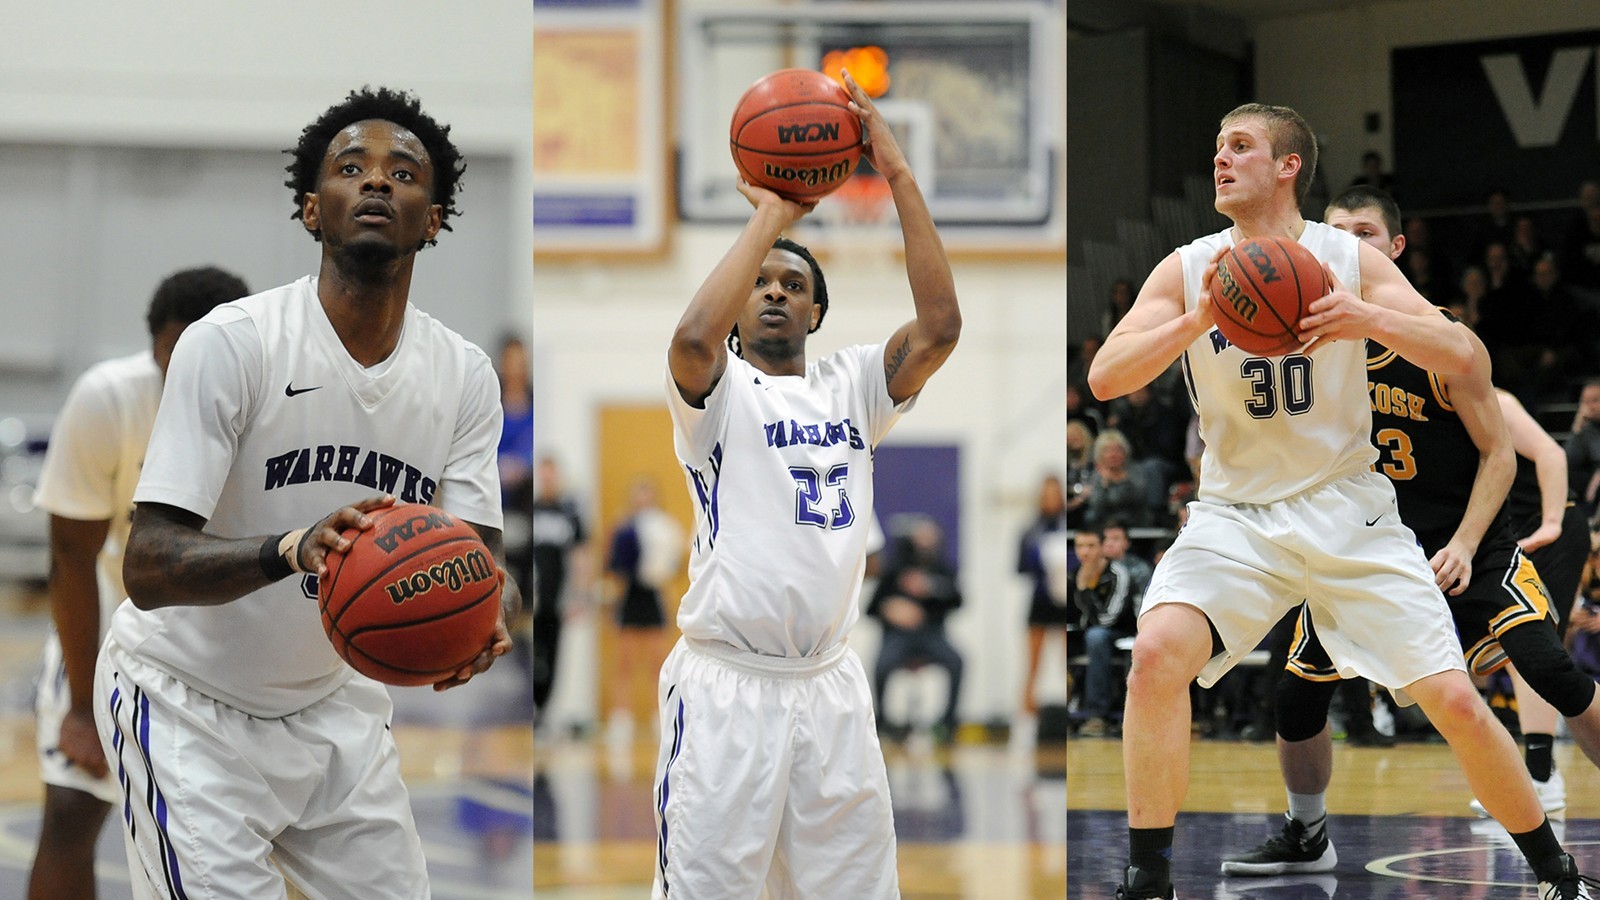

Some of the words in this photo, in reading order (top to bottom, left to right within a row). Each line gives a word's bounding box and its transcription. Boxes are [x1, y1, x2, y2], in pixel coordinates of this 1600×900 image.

[1479, 44, 1600, 149] V
[777, 121, 840, 144] NCAA
[764, 157, 850, 188] Wilson
[1217, 254, 1259, 324] Wilso
[1240, 353, 1314, 420] 30
[763, 418, 865, 450] WARHAWS
[1369, 428, 1418, 481] 3
[264, 444, 437, 506] WARHAWKS
[787, 462, 856, 530] 23
[373, 512, 455, 554] NCAA
[384, 547, 494, 605] Wilson
